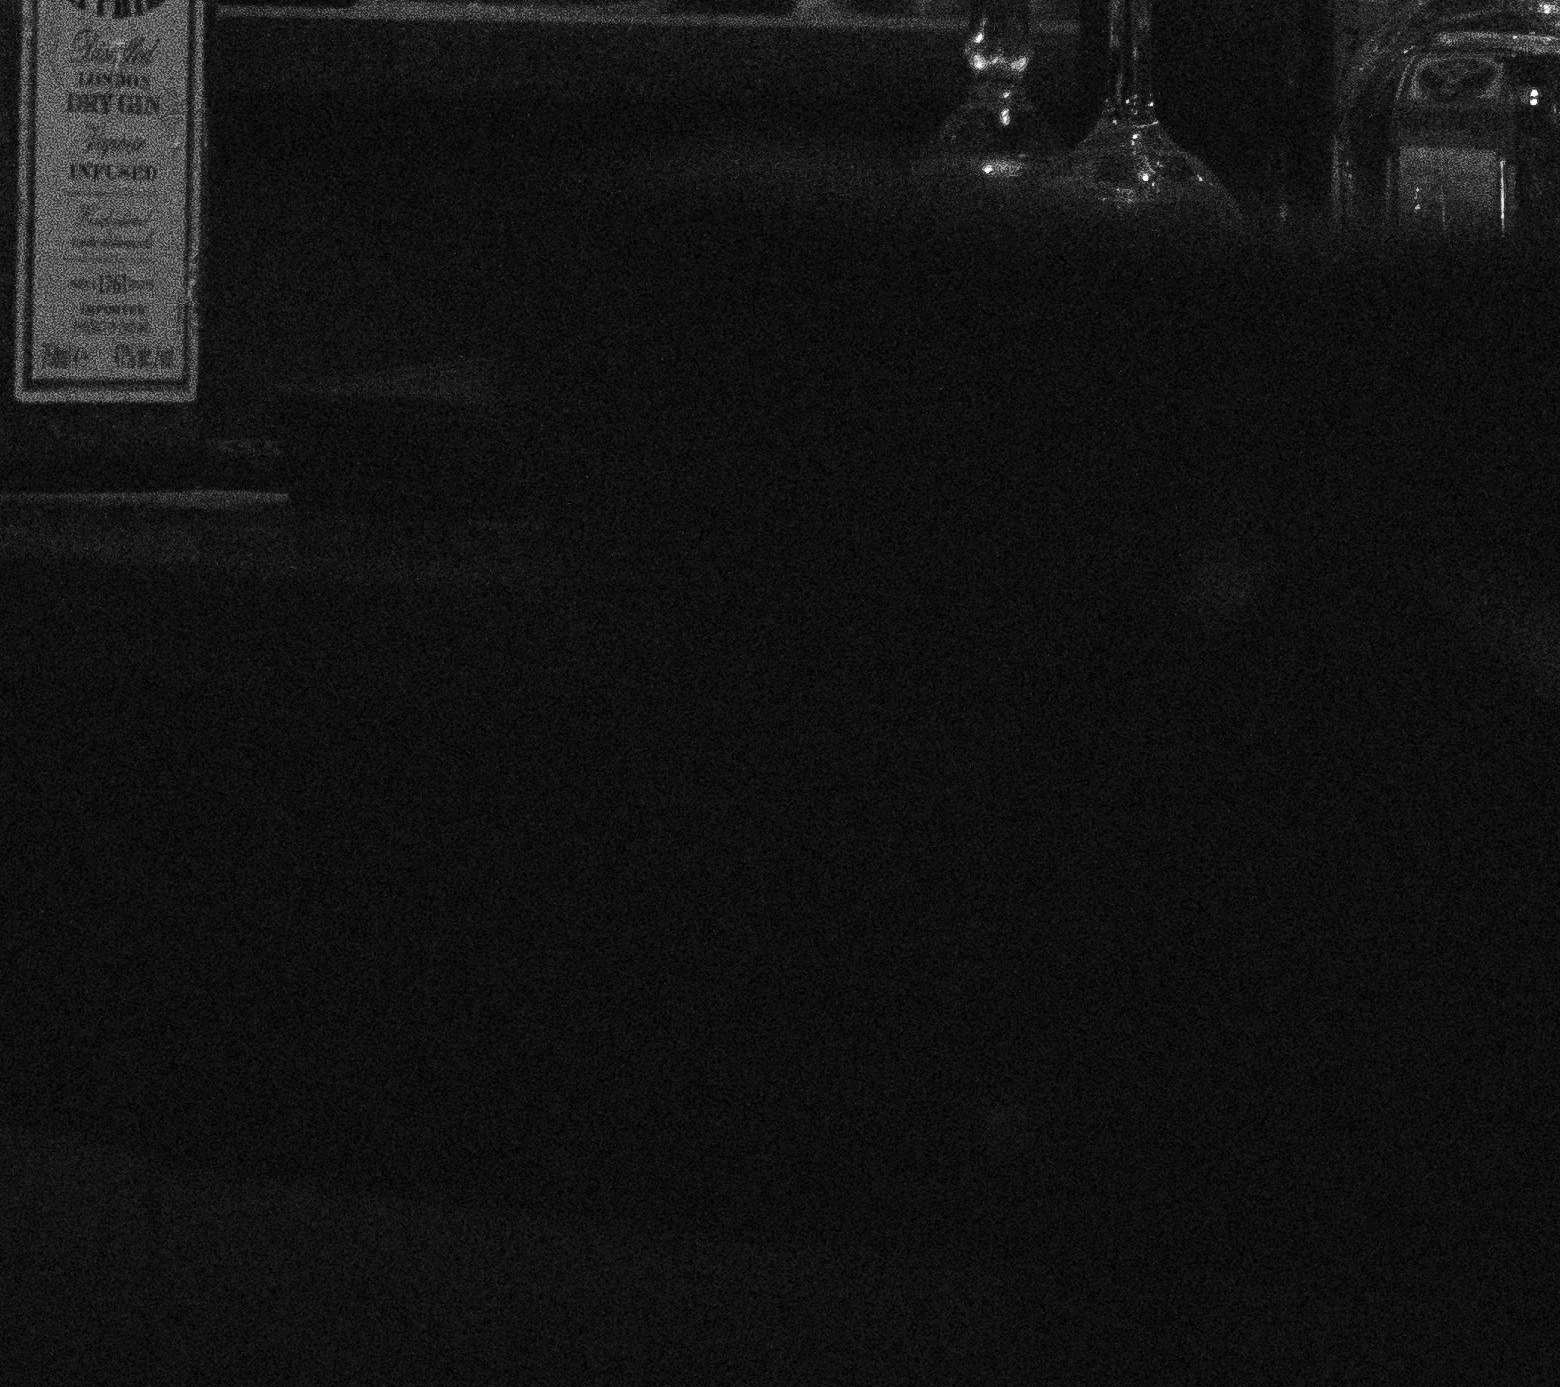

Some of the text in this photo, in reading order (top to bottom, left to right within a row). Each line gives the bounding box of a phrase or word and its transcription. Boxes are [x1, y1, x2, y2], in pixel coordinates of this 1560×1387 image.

[79, 72, 150, 87] LONDON
[66, 93, 160, 117] DRY GIN
[70, 163, 158, 182] INFUSED
